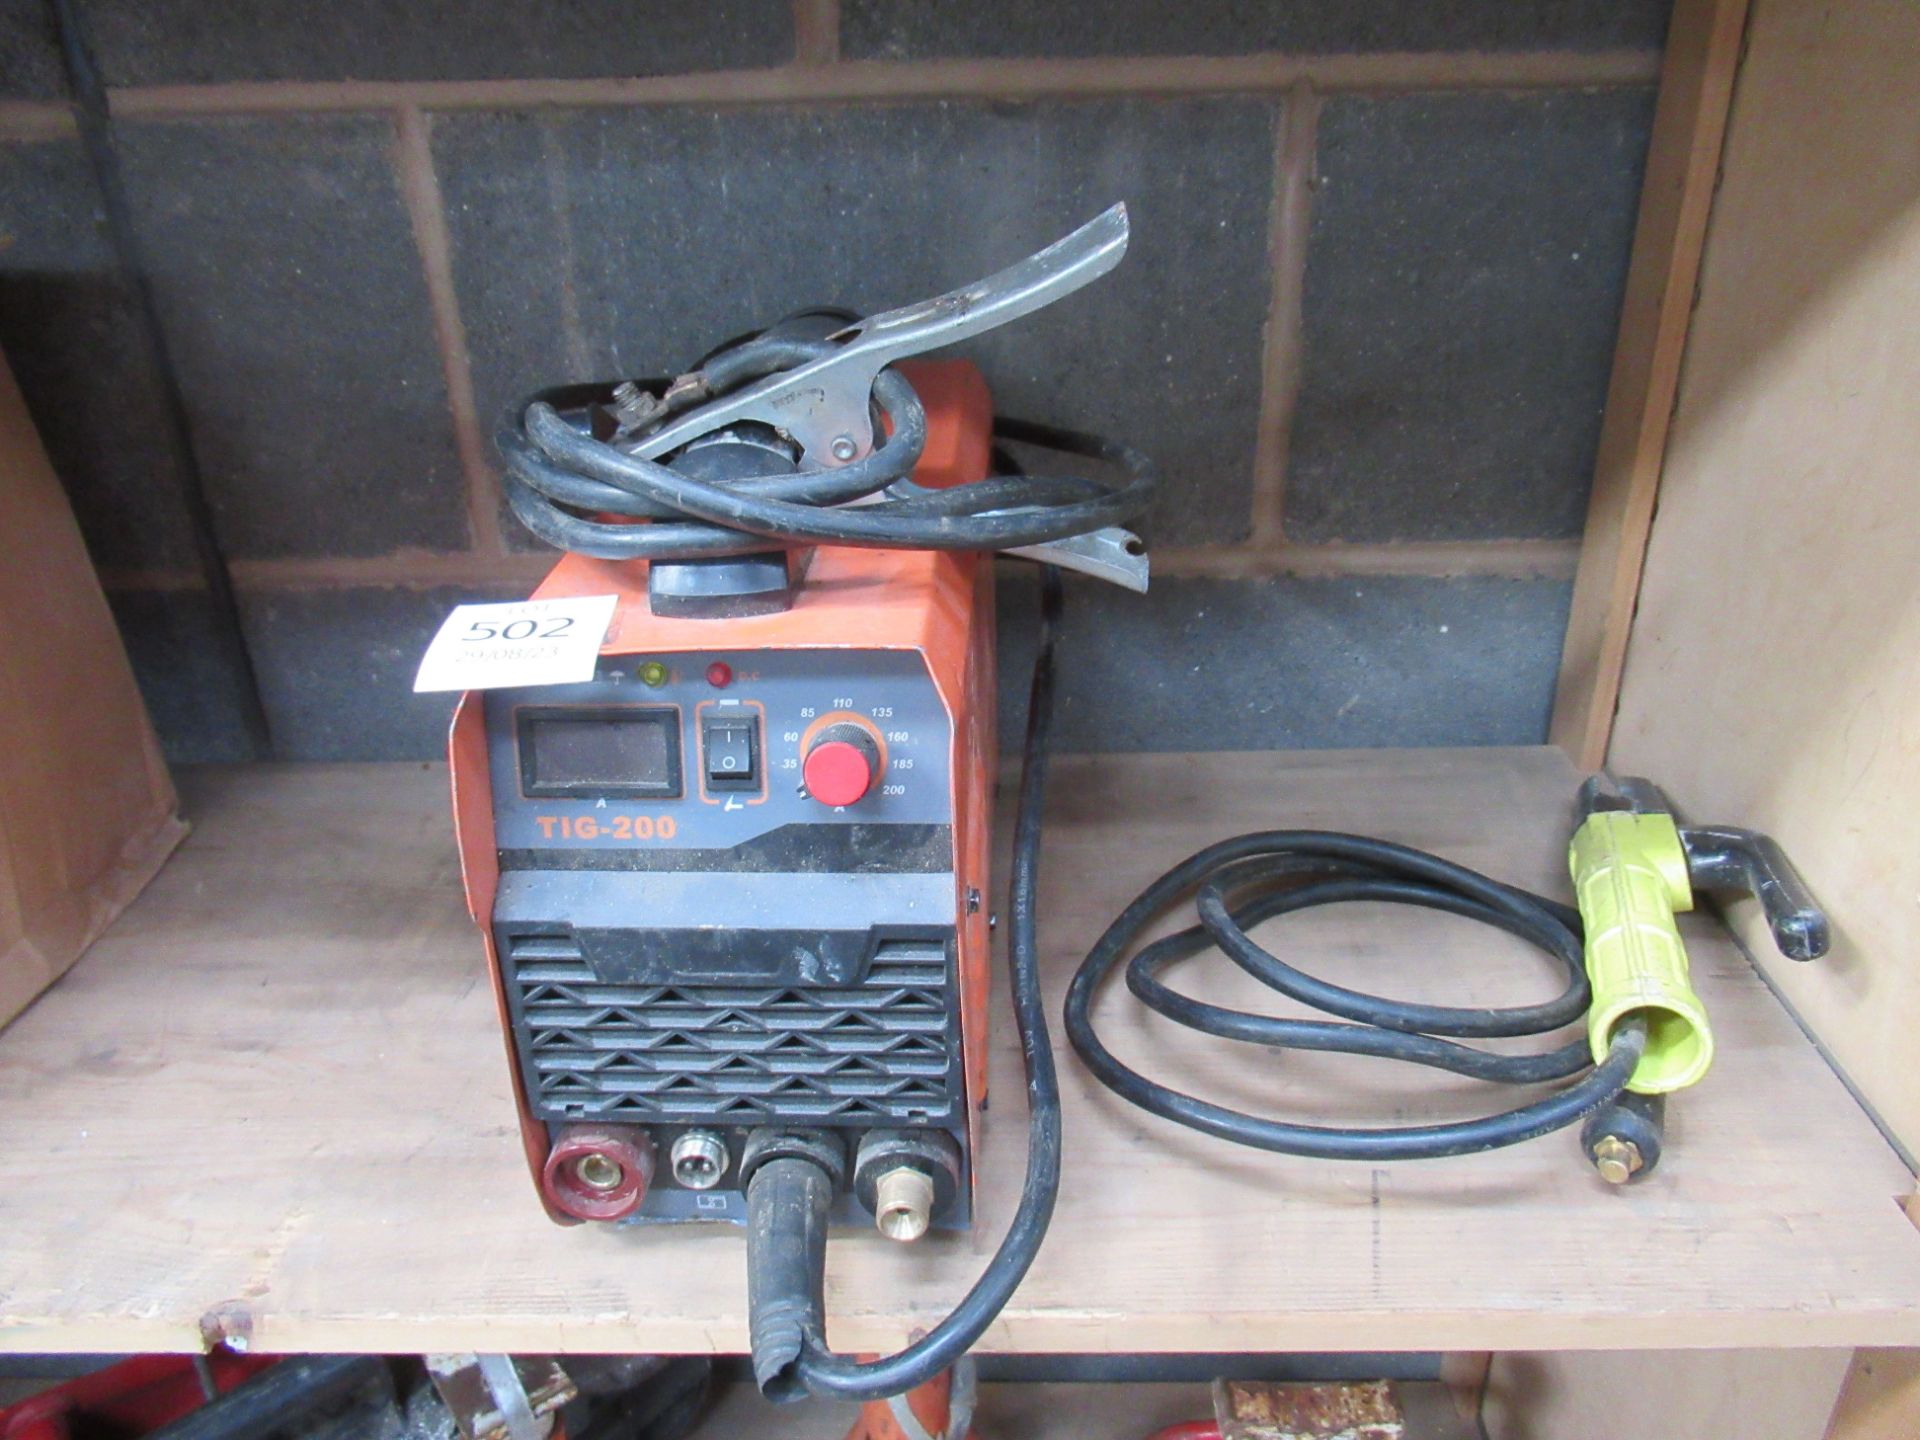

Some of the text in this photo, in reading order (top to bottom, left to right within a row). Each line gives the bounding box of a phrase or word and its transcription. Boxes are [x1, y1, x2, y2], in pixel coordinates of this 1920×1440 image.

[461, 617, 575, 641] 502
[832, 698, 853, 708] 110
[800, 708, 815, 718] 85
[871, 707, 893, 717] 135
[783, 732, 798, 742] 60
[887, 731, 909, 742] 160
[781, 759, 798, 769] 35
[892, 759, 913, 769] 185
[883, 785, 905, 795] 200
[595, 798, 607, 809] A
[536, 815, 677, 840] TIG-200
